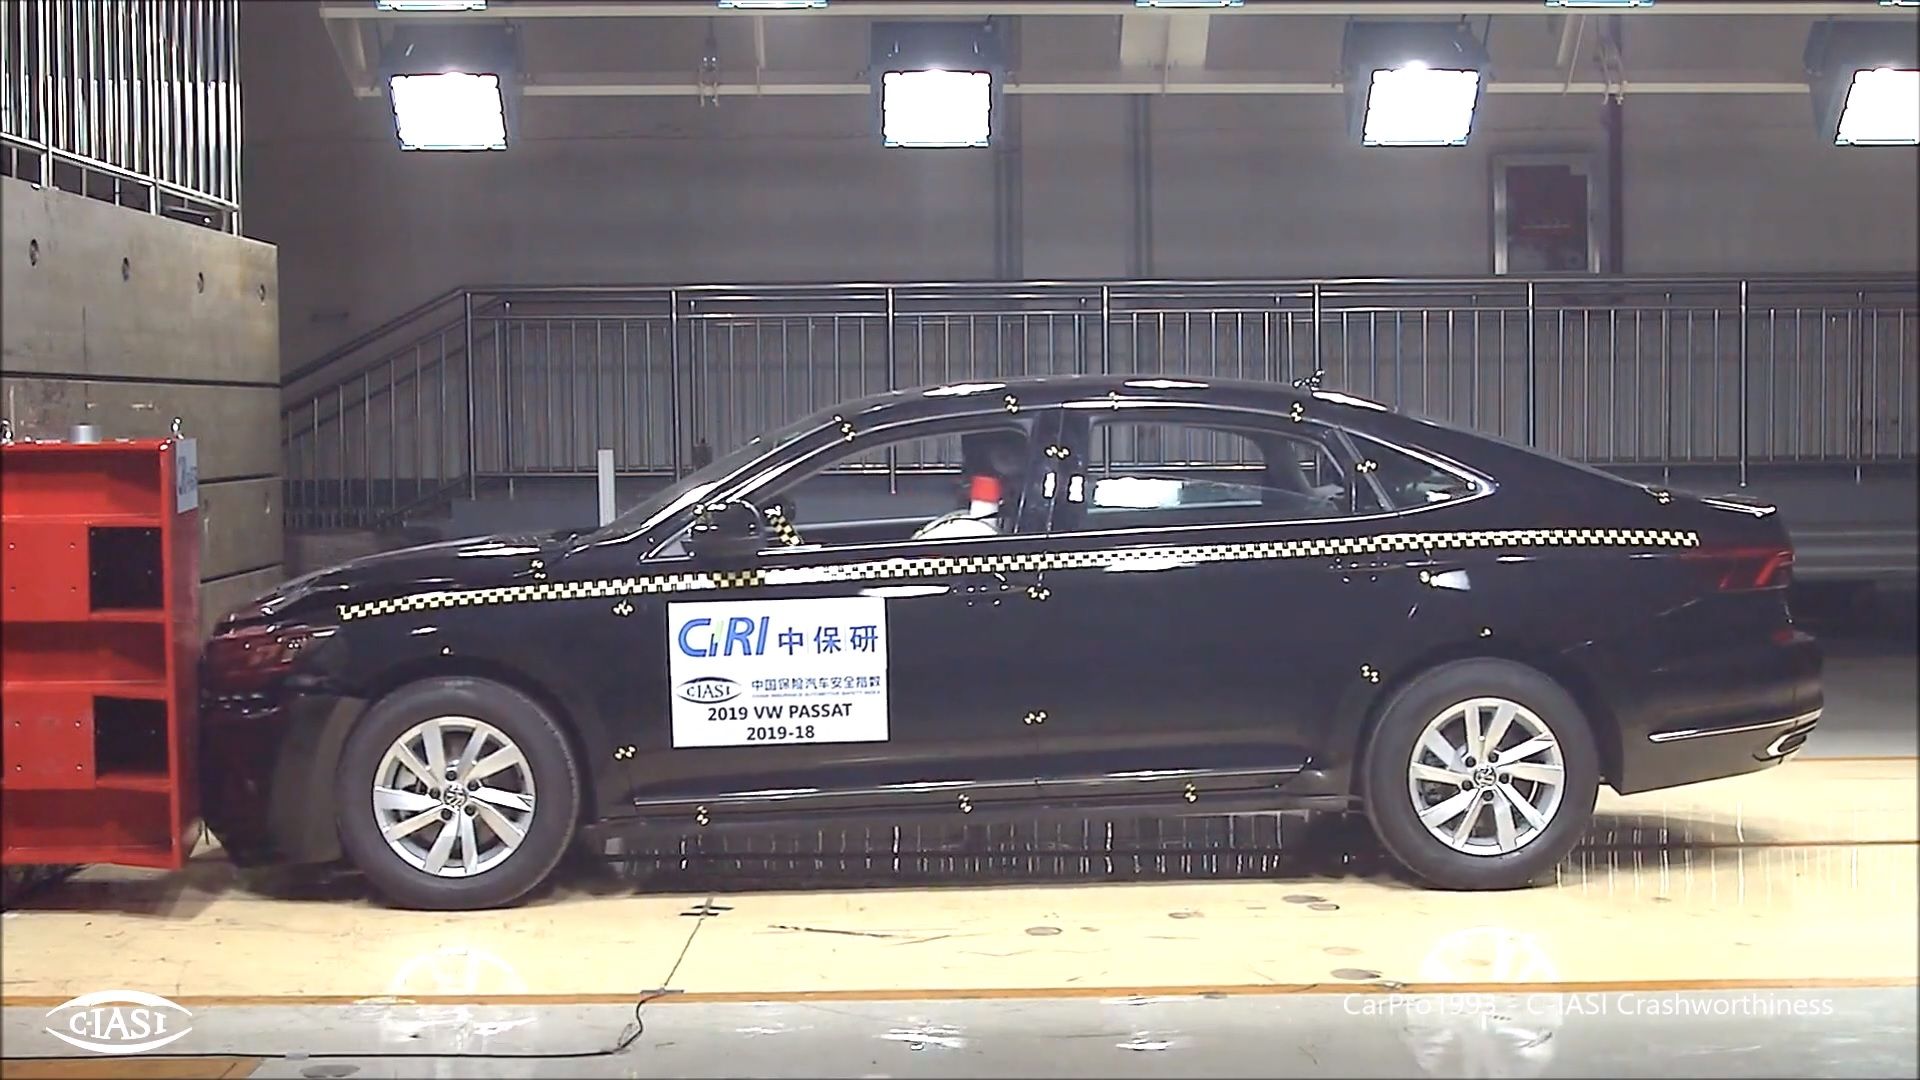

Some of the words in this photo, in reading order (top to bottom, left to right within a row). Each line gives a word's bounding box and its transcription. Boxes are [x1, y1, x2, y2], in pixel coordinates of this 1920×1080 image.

[778, 625, 879, 656] 中保研
[707, 706, 748, 721] 2019
[753, 705, 783, 720] VW
[789, 702, 853, 719] PASSAT
[746, 725, 815, 741] 2019-18
